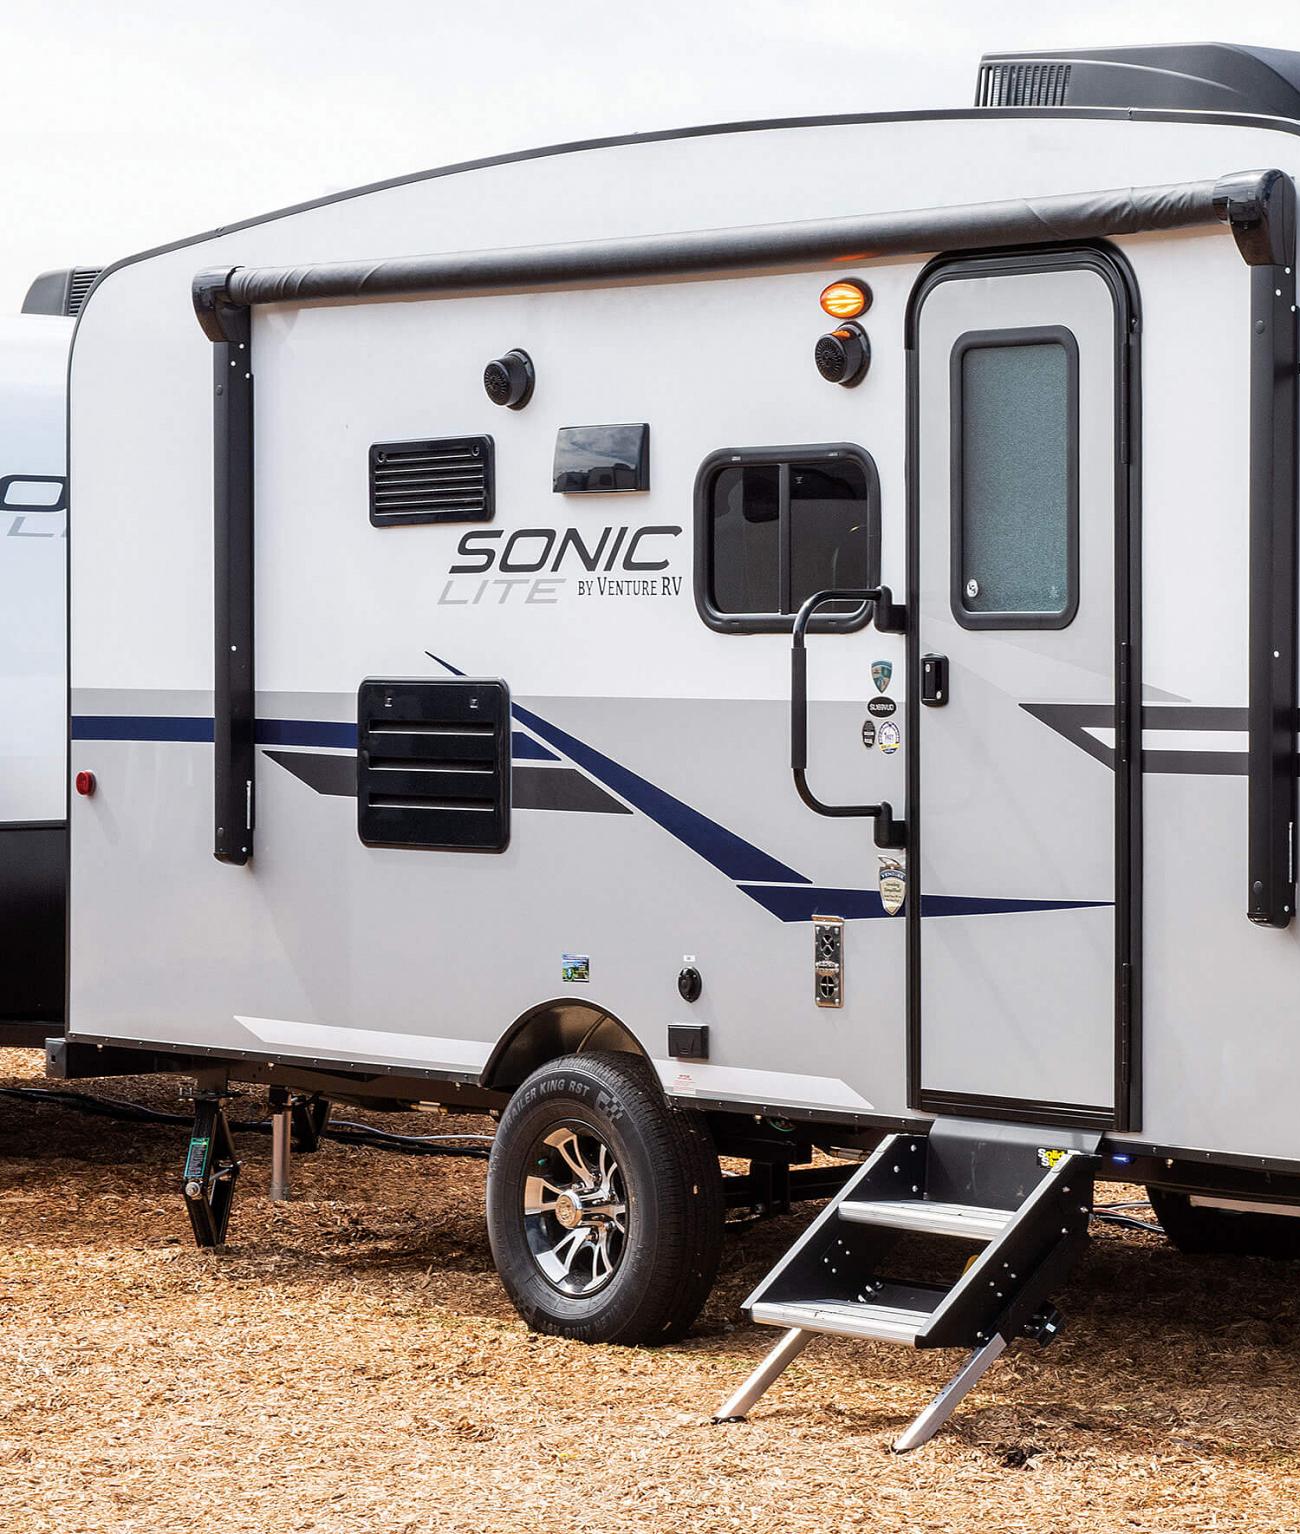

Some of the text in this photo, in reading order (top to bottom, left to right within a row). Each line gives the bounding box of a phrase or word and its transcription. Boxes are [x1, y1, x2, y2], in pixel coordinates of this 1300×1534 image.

[448, 525, 683, 574] SONIC
[437, 578, 566, 605] LITE
[578, 580, 594, 596] BY
[661, 577, 683, 596] RV
[502, 1079, 590, 1134] TRAILER KING RST
